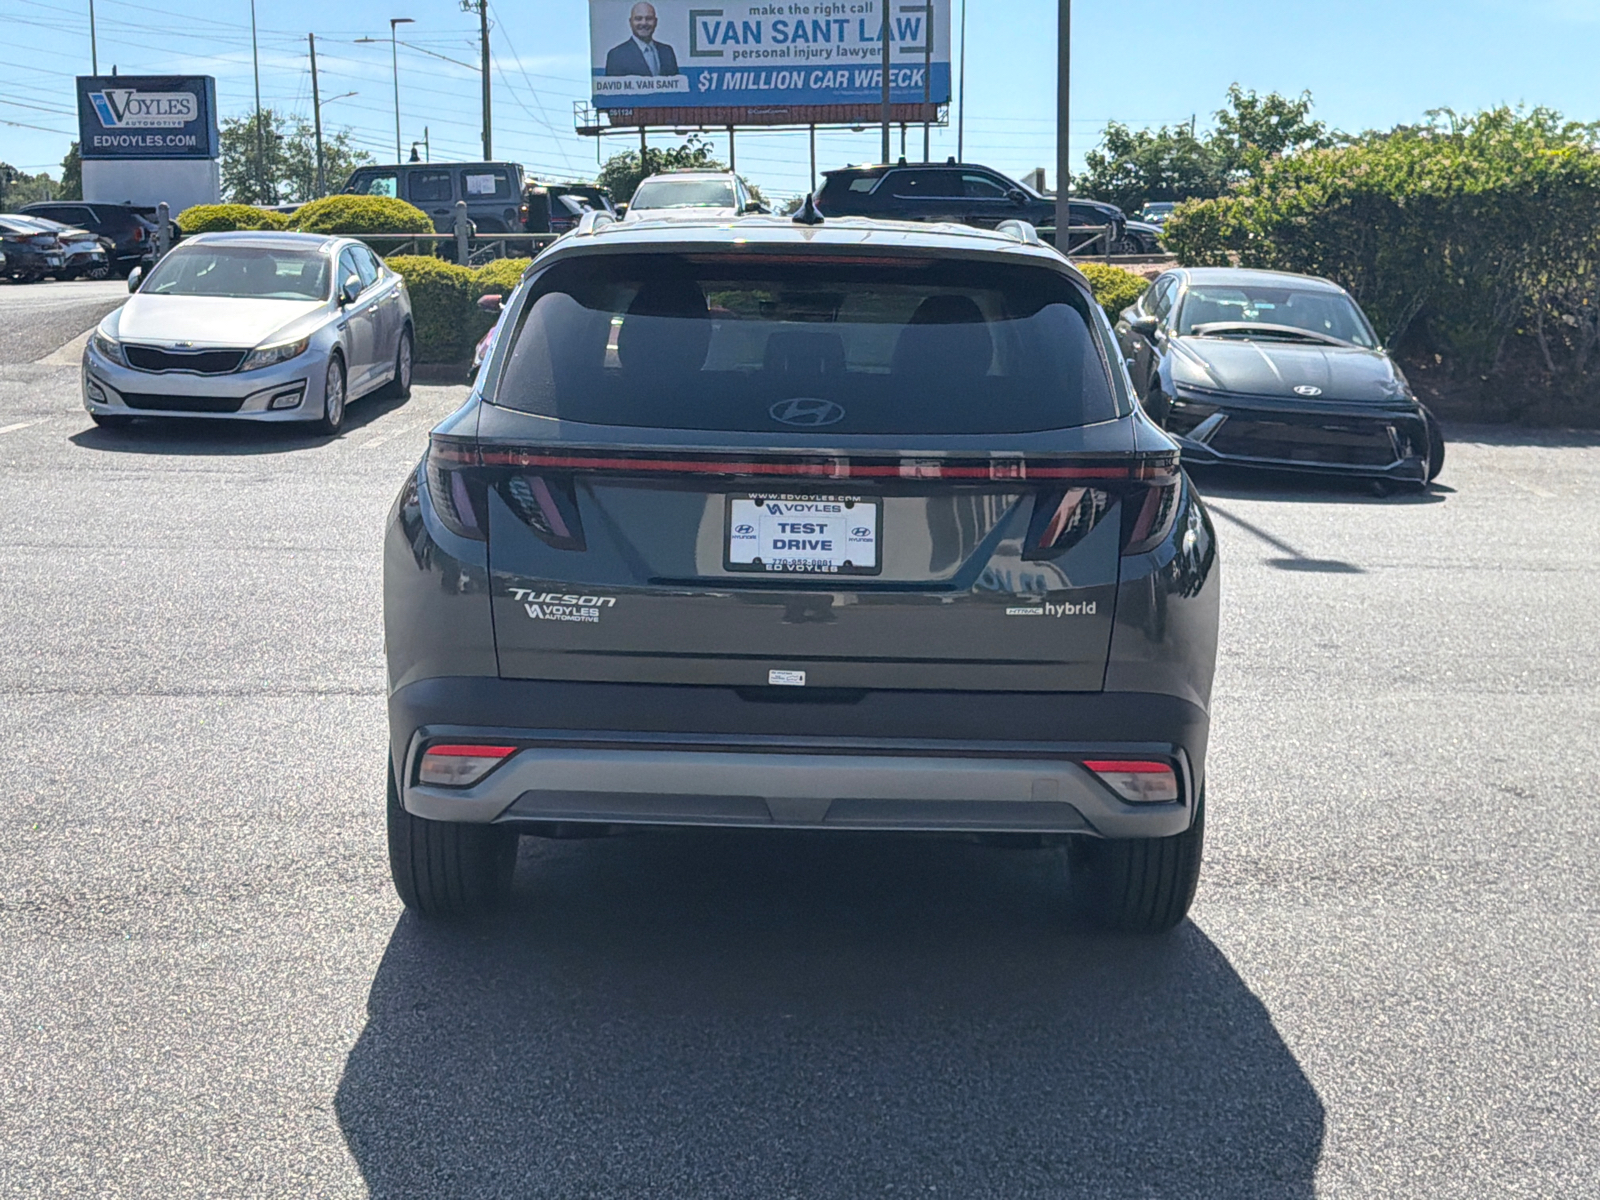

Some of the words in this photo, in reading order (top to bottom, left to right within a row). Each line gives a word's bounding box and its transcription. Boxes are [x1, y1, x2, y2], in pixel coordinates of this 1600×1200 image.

[749, 4, 784, 15] make
[789, 3, 809, 15] the
[814, 2, 846, 17] right
[850, 1, 873, 14] call
[702, 20, 762, 45] VAN
[771, 18, 850, 44] SANT
[859, 17, 921, 42] LAW
[733, 45, 790, 61] personal
[794, 44, 833, 60] injury
[836, 44, 884, 59] lawyer
[597, 80, 621, 91] DAVID
[624, 80, 635, 90] M.
[636, 80, 654, 90] VAN
[656, 79, 679, 89] SANT
[698, 70, 718, 93] $1
[723, 71, 805, 90] MILLION
[809, 70, 849, 89] CAR
[854, 68, 926, 88] WRECK
[104, 91, 192, 123] VOYLES
[93, 135, 197, 147] EDVOYLES.COM
[748, 493, 861, 502] WWW.EDVOYLES.COM
[784, 503, 841, 513] VOYLES
[778, 523, 828, 535] TEST
[773, 539, 832, 551] DRIVE
[787, 564, 838, 573] VOYLES
[508, 587, 616, 608] TUCSON
[543, 605, 600, 617] VOYLES
[1045, 601, 1096, 618] hybrid
[544, 613, 599, 623] AUTOMOTIVE
